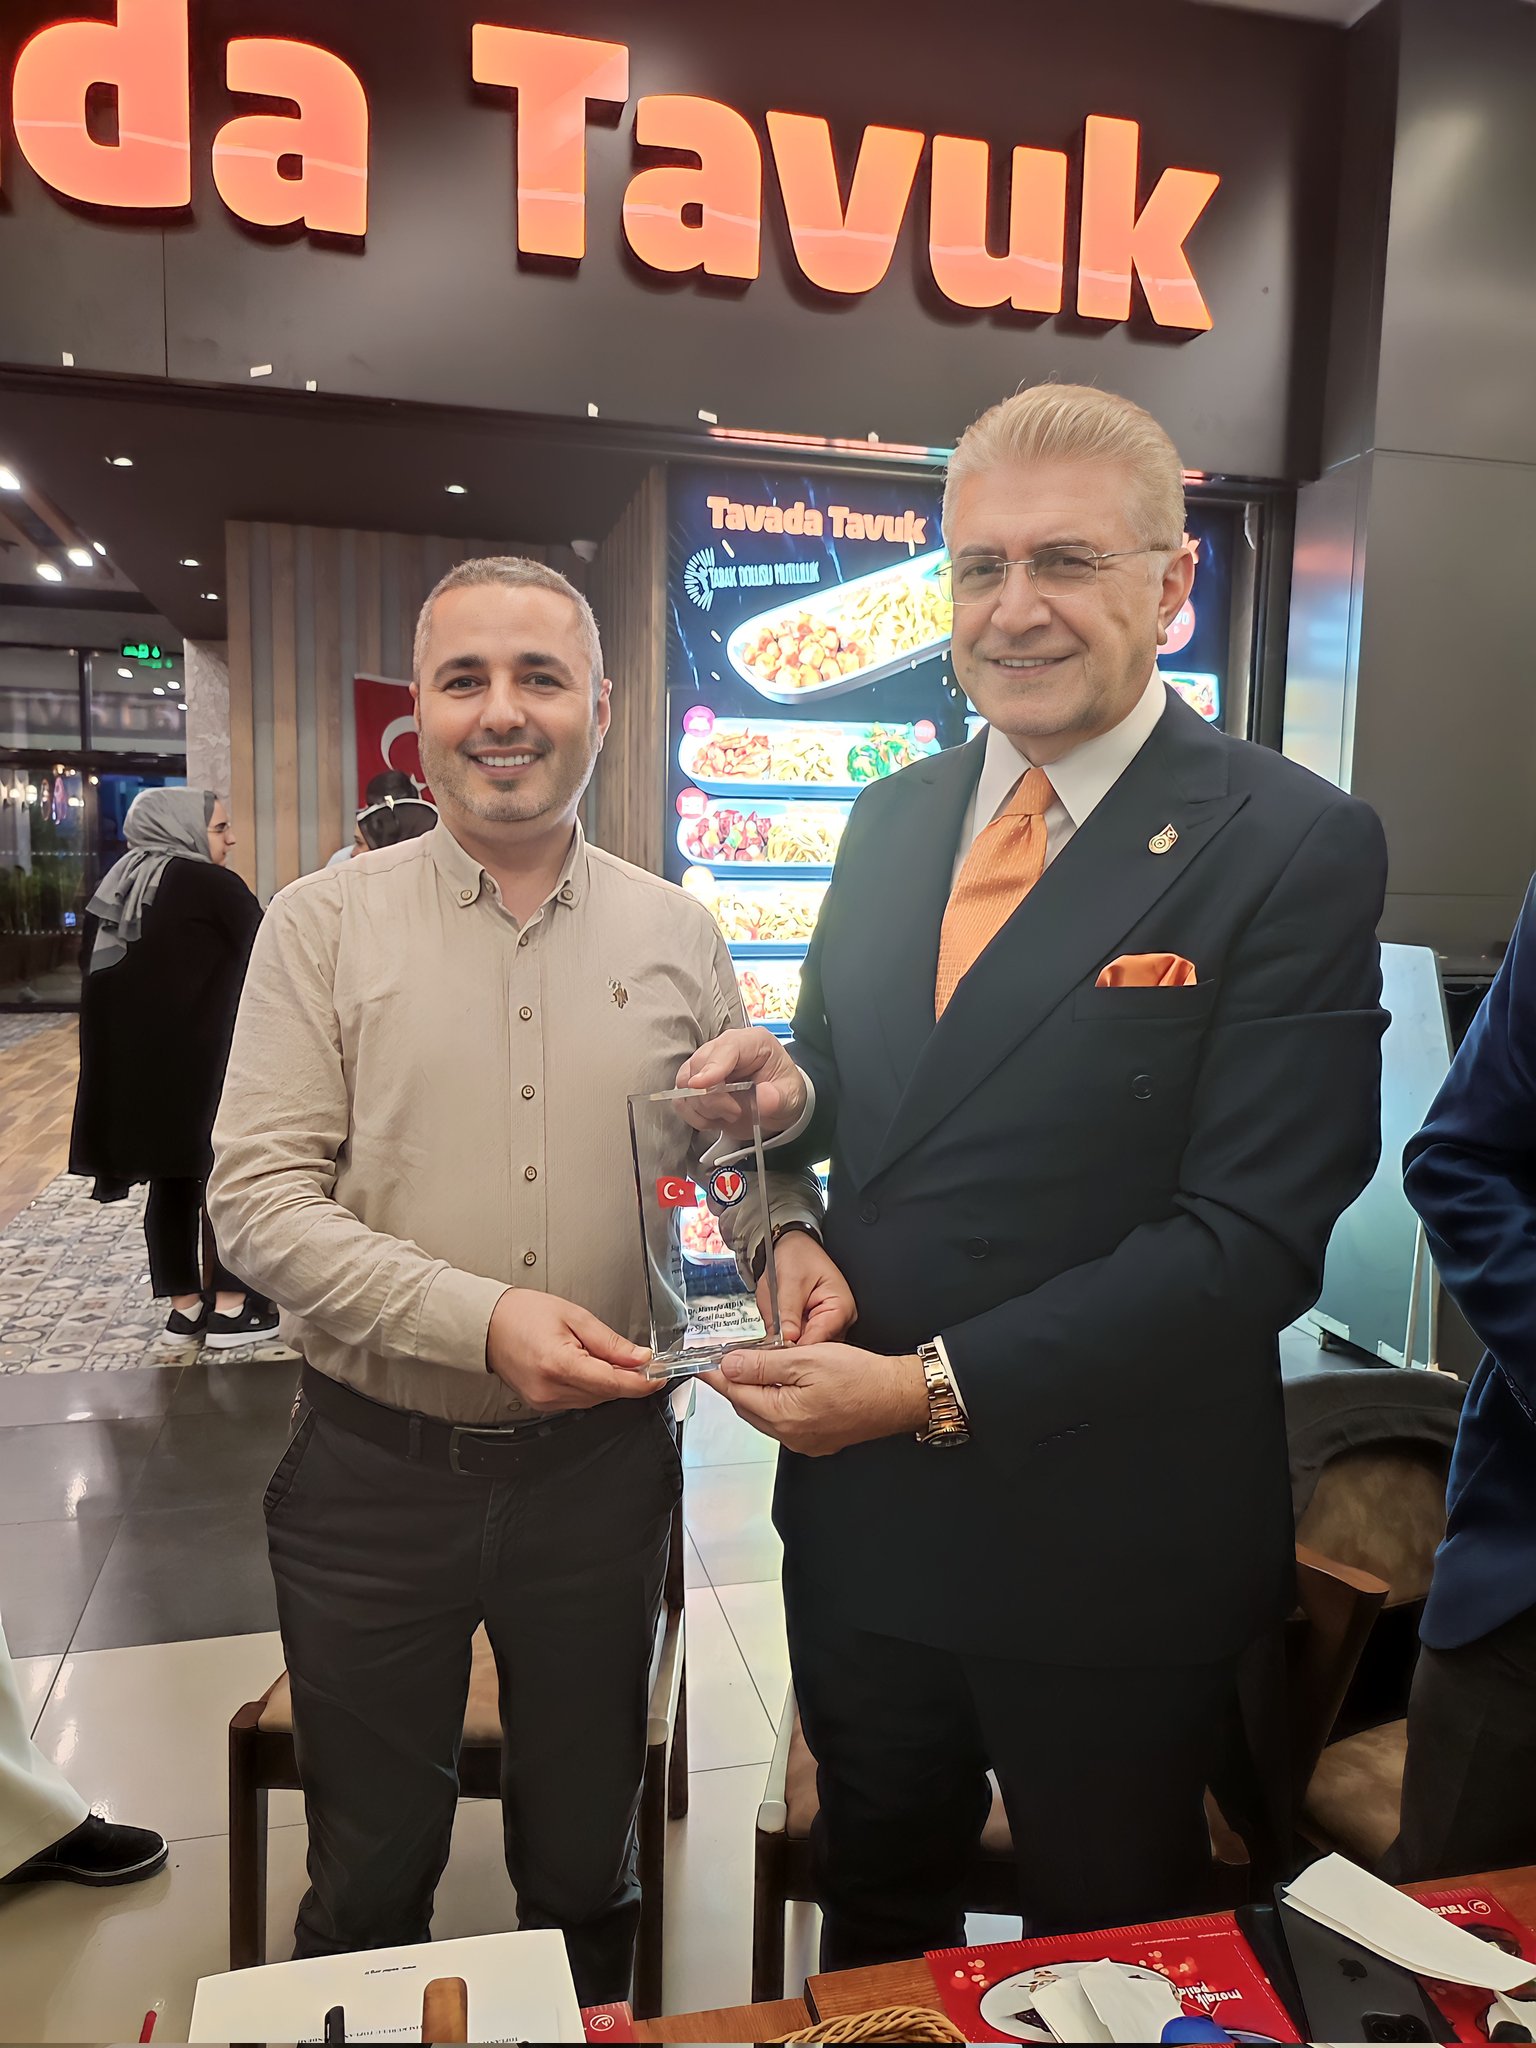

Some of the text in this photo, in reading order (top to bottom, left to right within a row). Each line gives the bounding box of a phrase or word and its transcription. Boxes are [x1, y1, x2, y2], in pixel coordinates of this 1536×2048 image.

[0, 0, 1220, 332] da Tavuk
[706, 495, 929, 544] Tavada Tavuk
